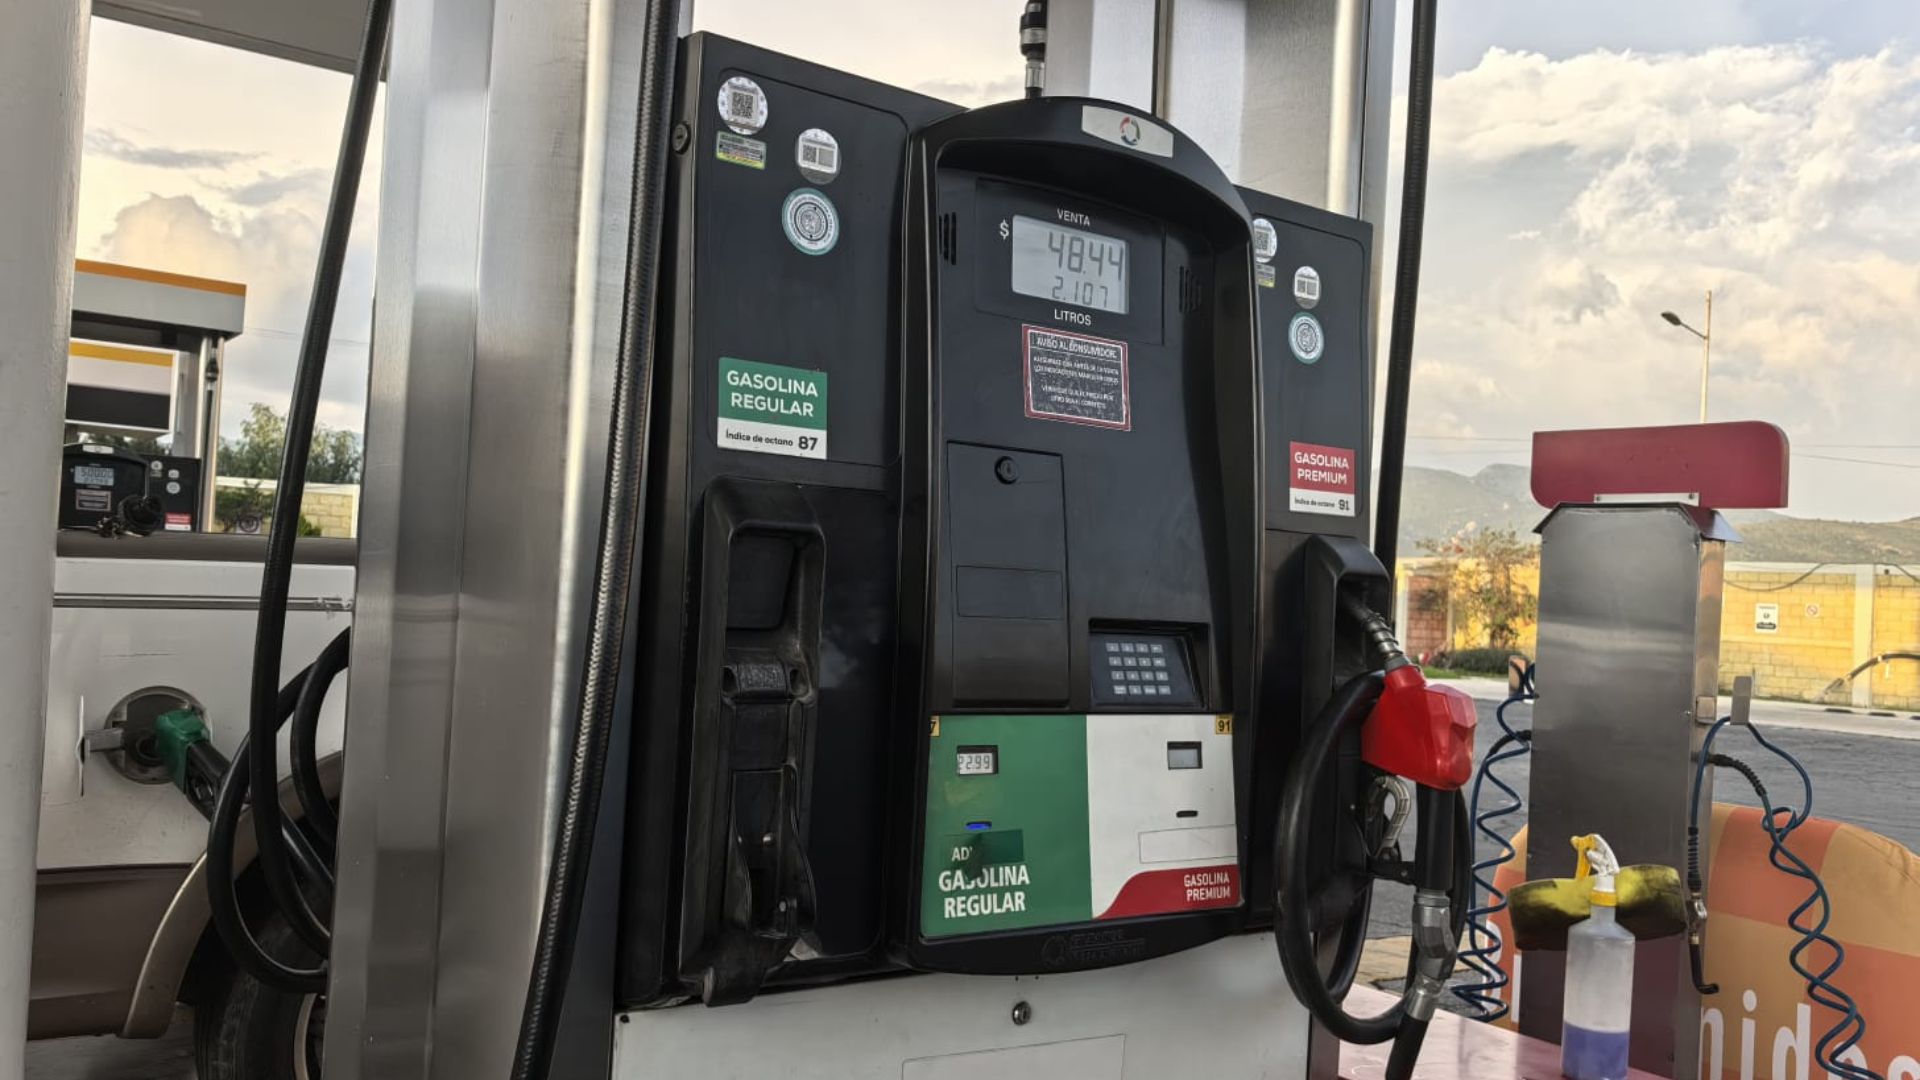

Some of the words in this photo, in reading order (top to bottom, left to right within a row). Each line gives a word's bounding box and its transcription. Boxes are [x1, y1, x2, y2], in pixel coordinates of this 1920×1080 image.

[1057, 208, 1090, 226] VENTA
[1000, 219, 1009, 240] $
[1048, 231, 1124, 282] 48.44
[1052, 276, 1108, 308] 2.107
[1054, 309, 1092, 326] LITROS
[727, 370, 818, 397] GASOLINA
[731, 392, 814, 417] REGULAR
[753, 434, 763, 443] de
[798, 435, 818, 451] 87
[1294, 451, 1349, 470] GASOLINA
[1297, 468, 1347, 485] PREMIUM
[1338, 499, 1350, 511] 91
[1218, 719, 1230, 732] 91
[1184, 871, 1230, 888] GASOLINA
[1187, 885, 1231, 902] PREMIUM
[944, 891, 1026, 919] REGULAR
